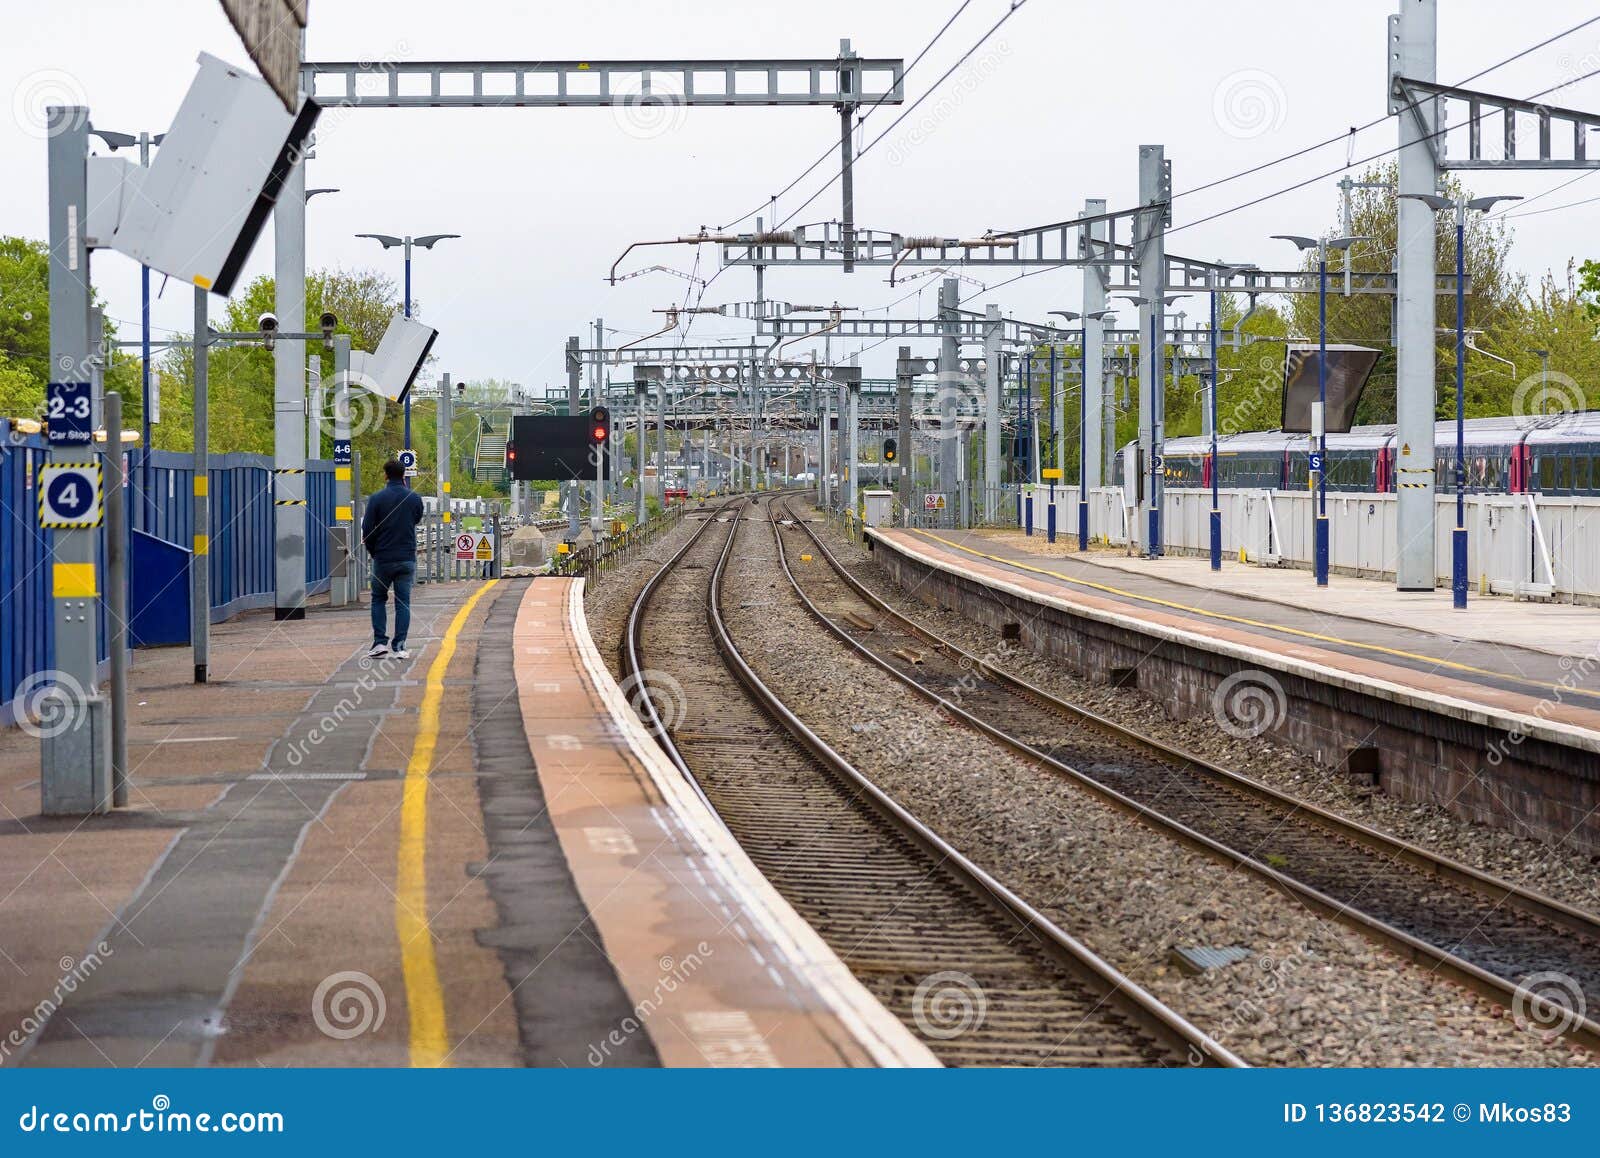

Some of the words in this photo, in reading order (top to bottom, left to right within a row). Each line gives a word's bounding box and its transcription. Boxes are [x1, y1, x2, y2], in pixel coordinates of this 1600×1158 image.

[49, 396, 90, 419] 2-3
[49, 431, 65, 440] Car
[68, 430, 90, 441] Stop
[334, 444, 351, 454] 4-6
[1312, 457, 1320, 467] S
[58, 482, 79, 508] 4
